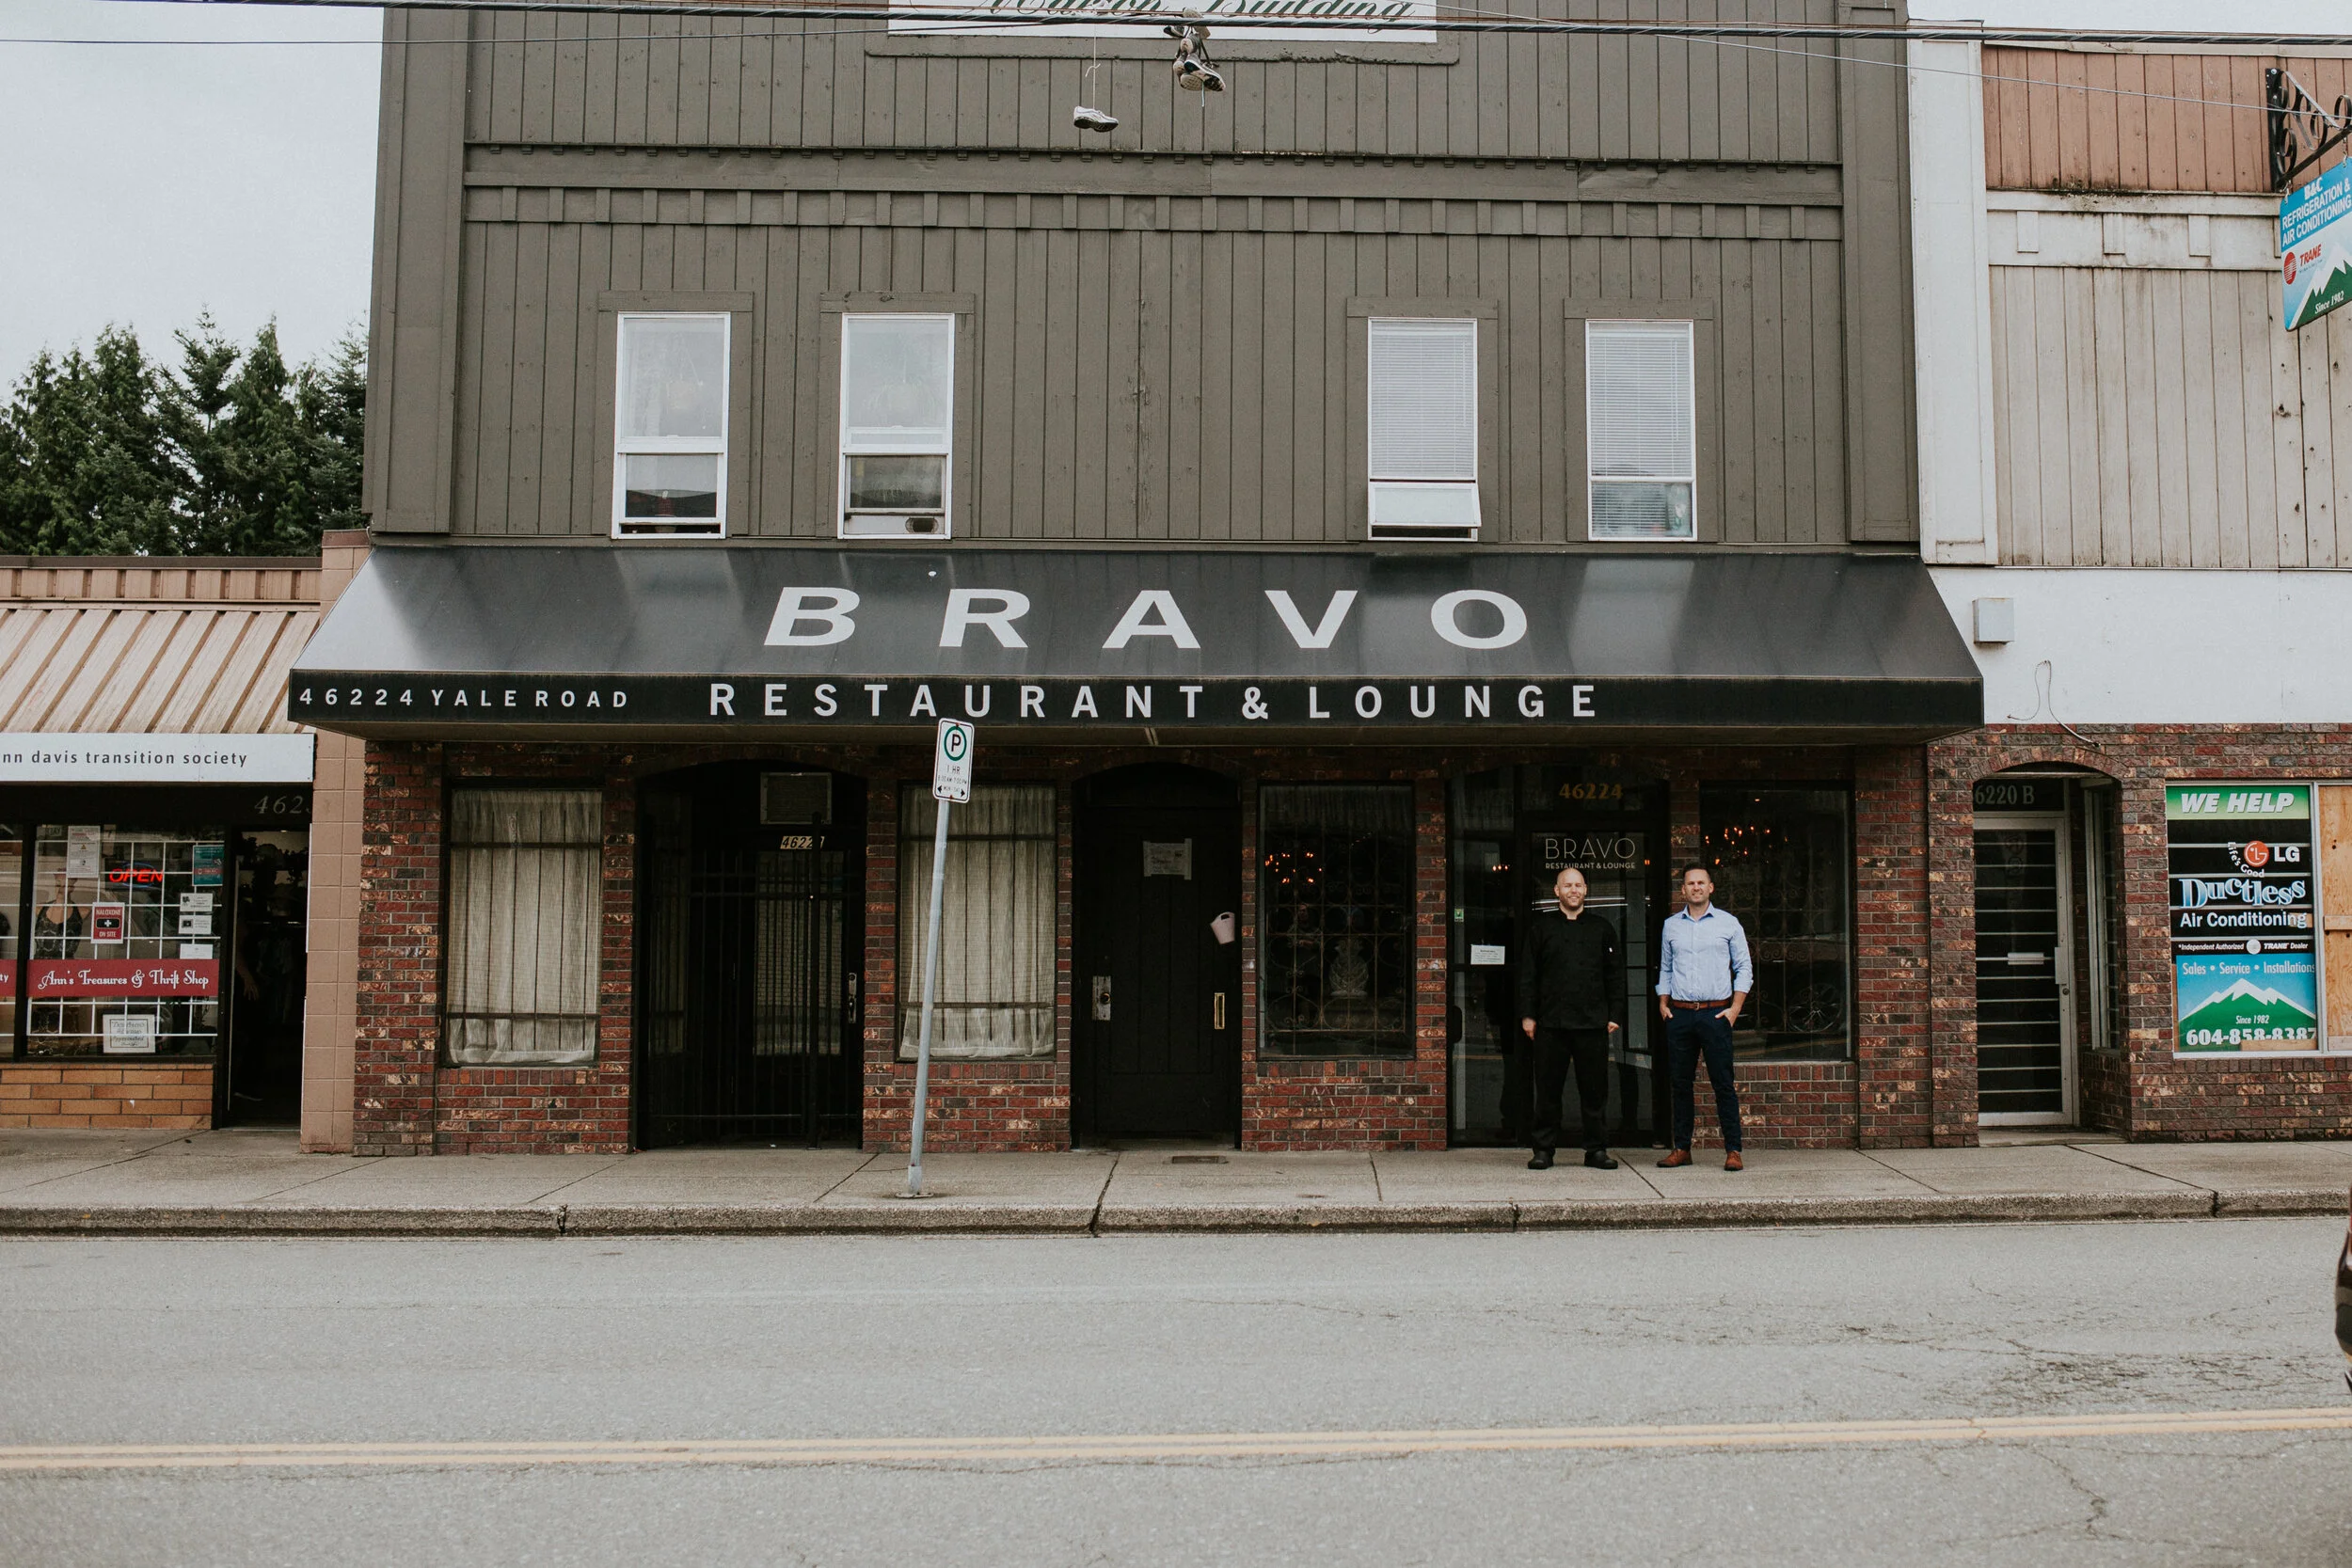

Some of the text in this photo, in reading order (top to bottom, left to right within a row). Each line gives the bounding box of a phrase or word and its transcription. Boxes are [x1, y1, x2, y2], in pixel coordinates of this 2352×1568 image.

[2304, 177, 2323, 200] B&C
[2282, 177, 2351, 230] REFRIGERATION &
[2282, 195, 2352, 247] AIR CONDITIONING
[2299, 244, 2322, 267] TRANE
[2314, 290, 2344, 315] Since 1982
[763, 586, 1529, 650] BRAVO
[299, 689, 628, 707] 46224 YALE ROAD
[709, 683, 1596, 721] RESTAURANT & LOUNGE
[950, 733, 961, 752] P
[31, 750, 77, 764] davis
[86, 750, 175, 764] transition
[183, 751, 247, 768] society
[1559, 783, 1623, 800] 46224
[2022, 784, 2035, 805] B
[254, 794, 311, 815] 462
[2181, 792, 2296, 814] WE HELP
[782, 836, 822, 848] 4622
[1545, 837, 1636, 860] BRAVO
[2274, 846, 2301, 863] LG
[109, 867, 164, 883] OPEN
[1545, 862, 1595, 870] RESTAURANT
[1603, 862, 1636, 870] LOUNGE
[2240, 863, 2265, 879] Good
[2178, 878, 2307, 910] Ductless
[2180, 910, 2308, 929] Air Conditioning
[2216, 942, 2245, 951] Authorized
[2290, 942, 2309, 950] Dealer
[2183, 960, 2315, 975] Sales Service Installations
[38, 968, 210, 990] Ann's Treasures & Thrift Shop
[2235, 1014, 2270, 1025] Since 1982
